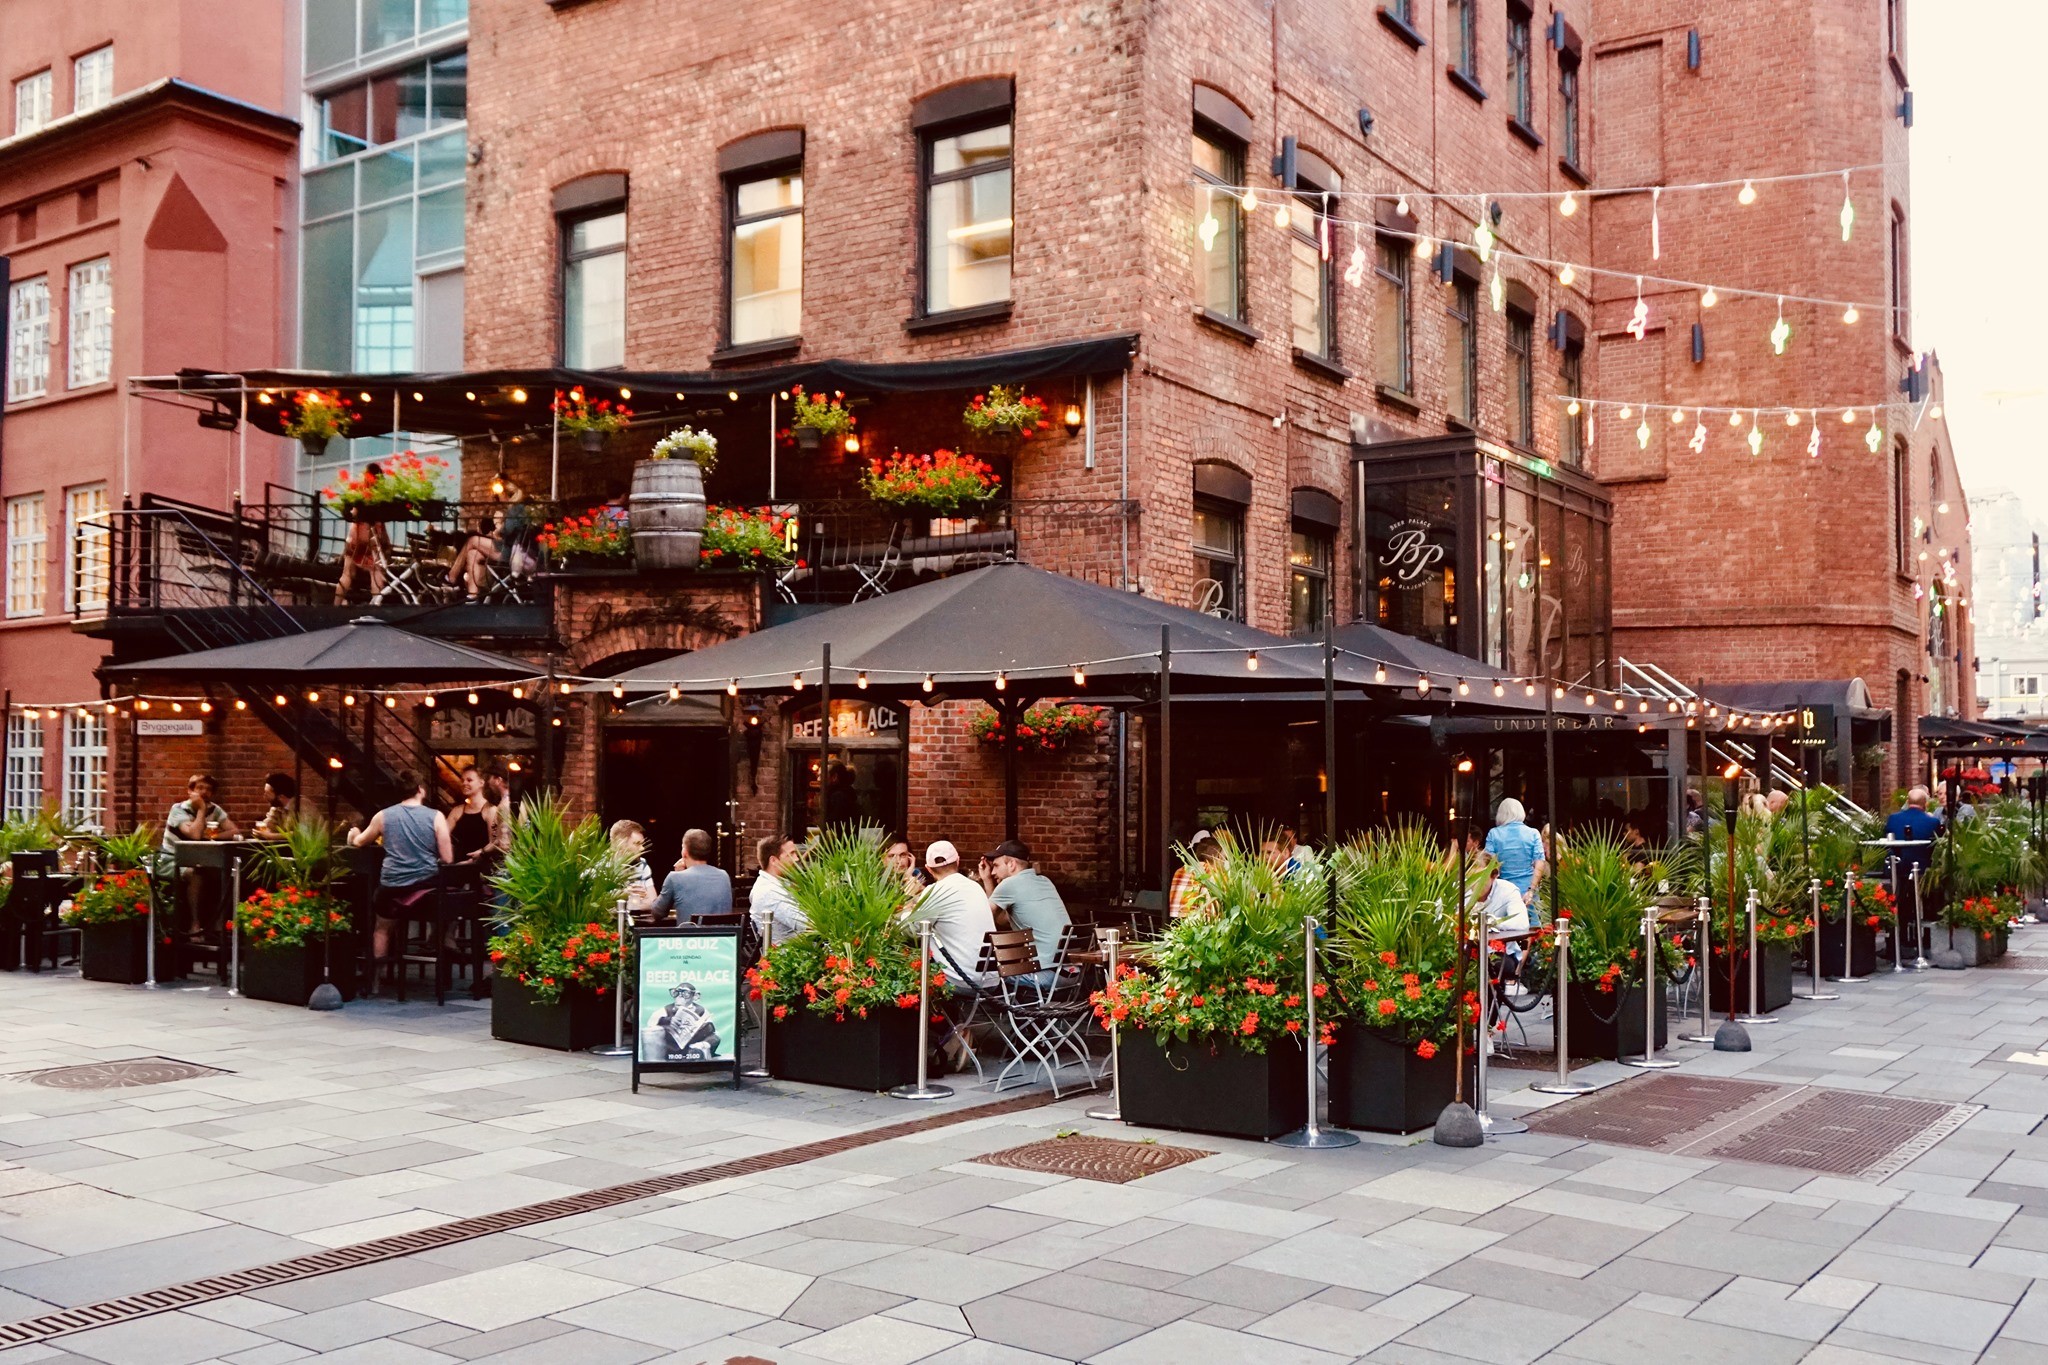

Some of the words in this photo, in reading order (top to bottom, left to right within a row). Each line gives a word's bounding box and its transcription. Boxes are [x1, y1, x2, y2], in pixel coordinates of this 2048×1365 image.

[1389, 520, 1405, 531] BEER
[1408, 518, 1432, 528] PALACE
[1379, 529, 1444, 580] BP
[141, 721, 194, 733] Bryggegata
[658, 939, 683, 950] PUB
[687, 939, 718, 950] QUIZ
[646, 971, 677, 982] BEER
[680, 970, 730, 982] PALACE
